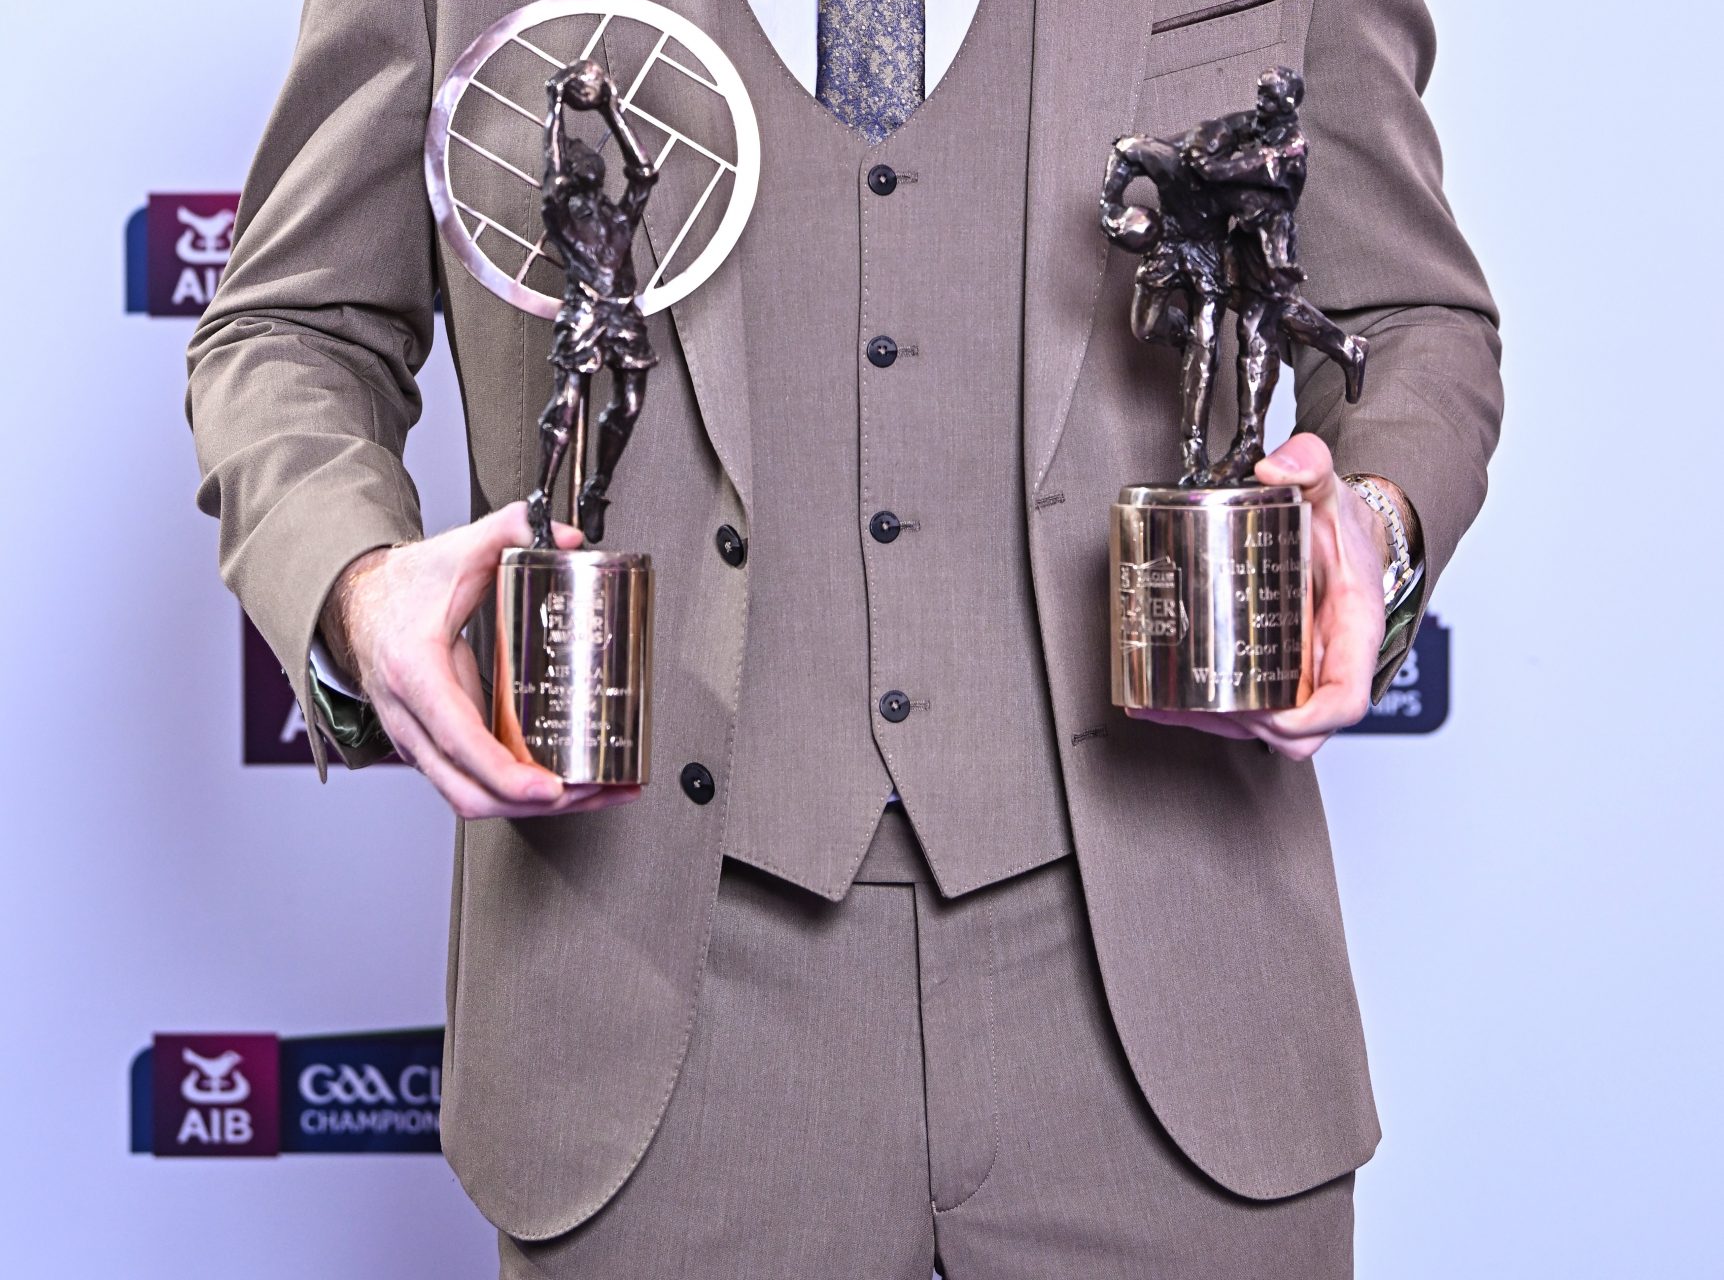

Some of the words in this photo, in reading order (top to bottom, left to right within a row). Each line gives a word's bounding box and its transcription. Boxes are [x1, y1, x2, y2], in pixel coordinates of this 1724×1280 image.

[172, 267, 224, 304] AI
[400, 1066, 440, 1104] CL
[177, 1108, 253, 1144] AIB
